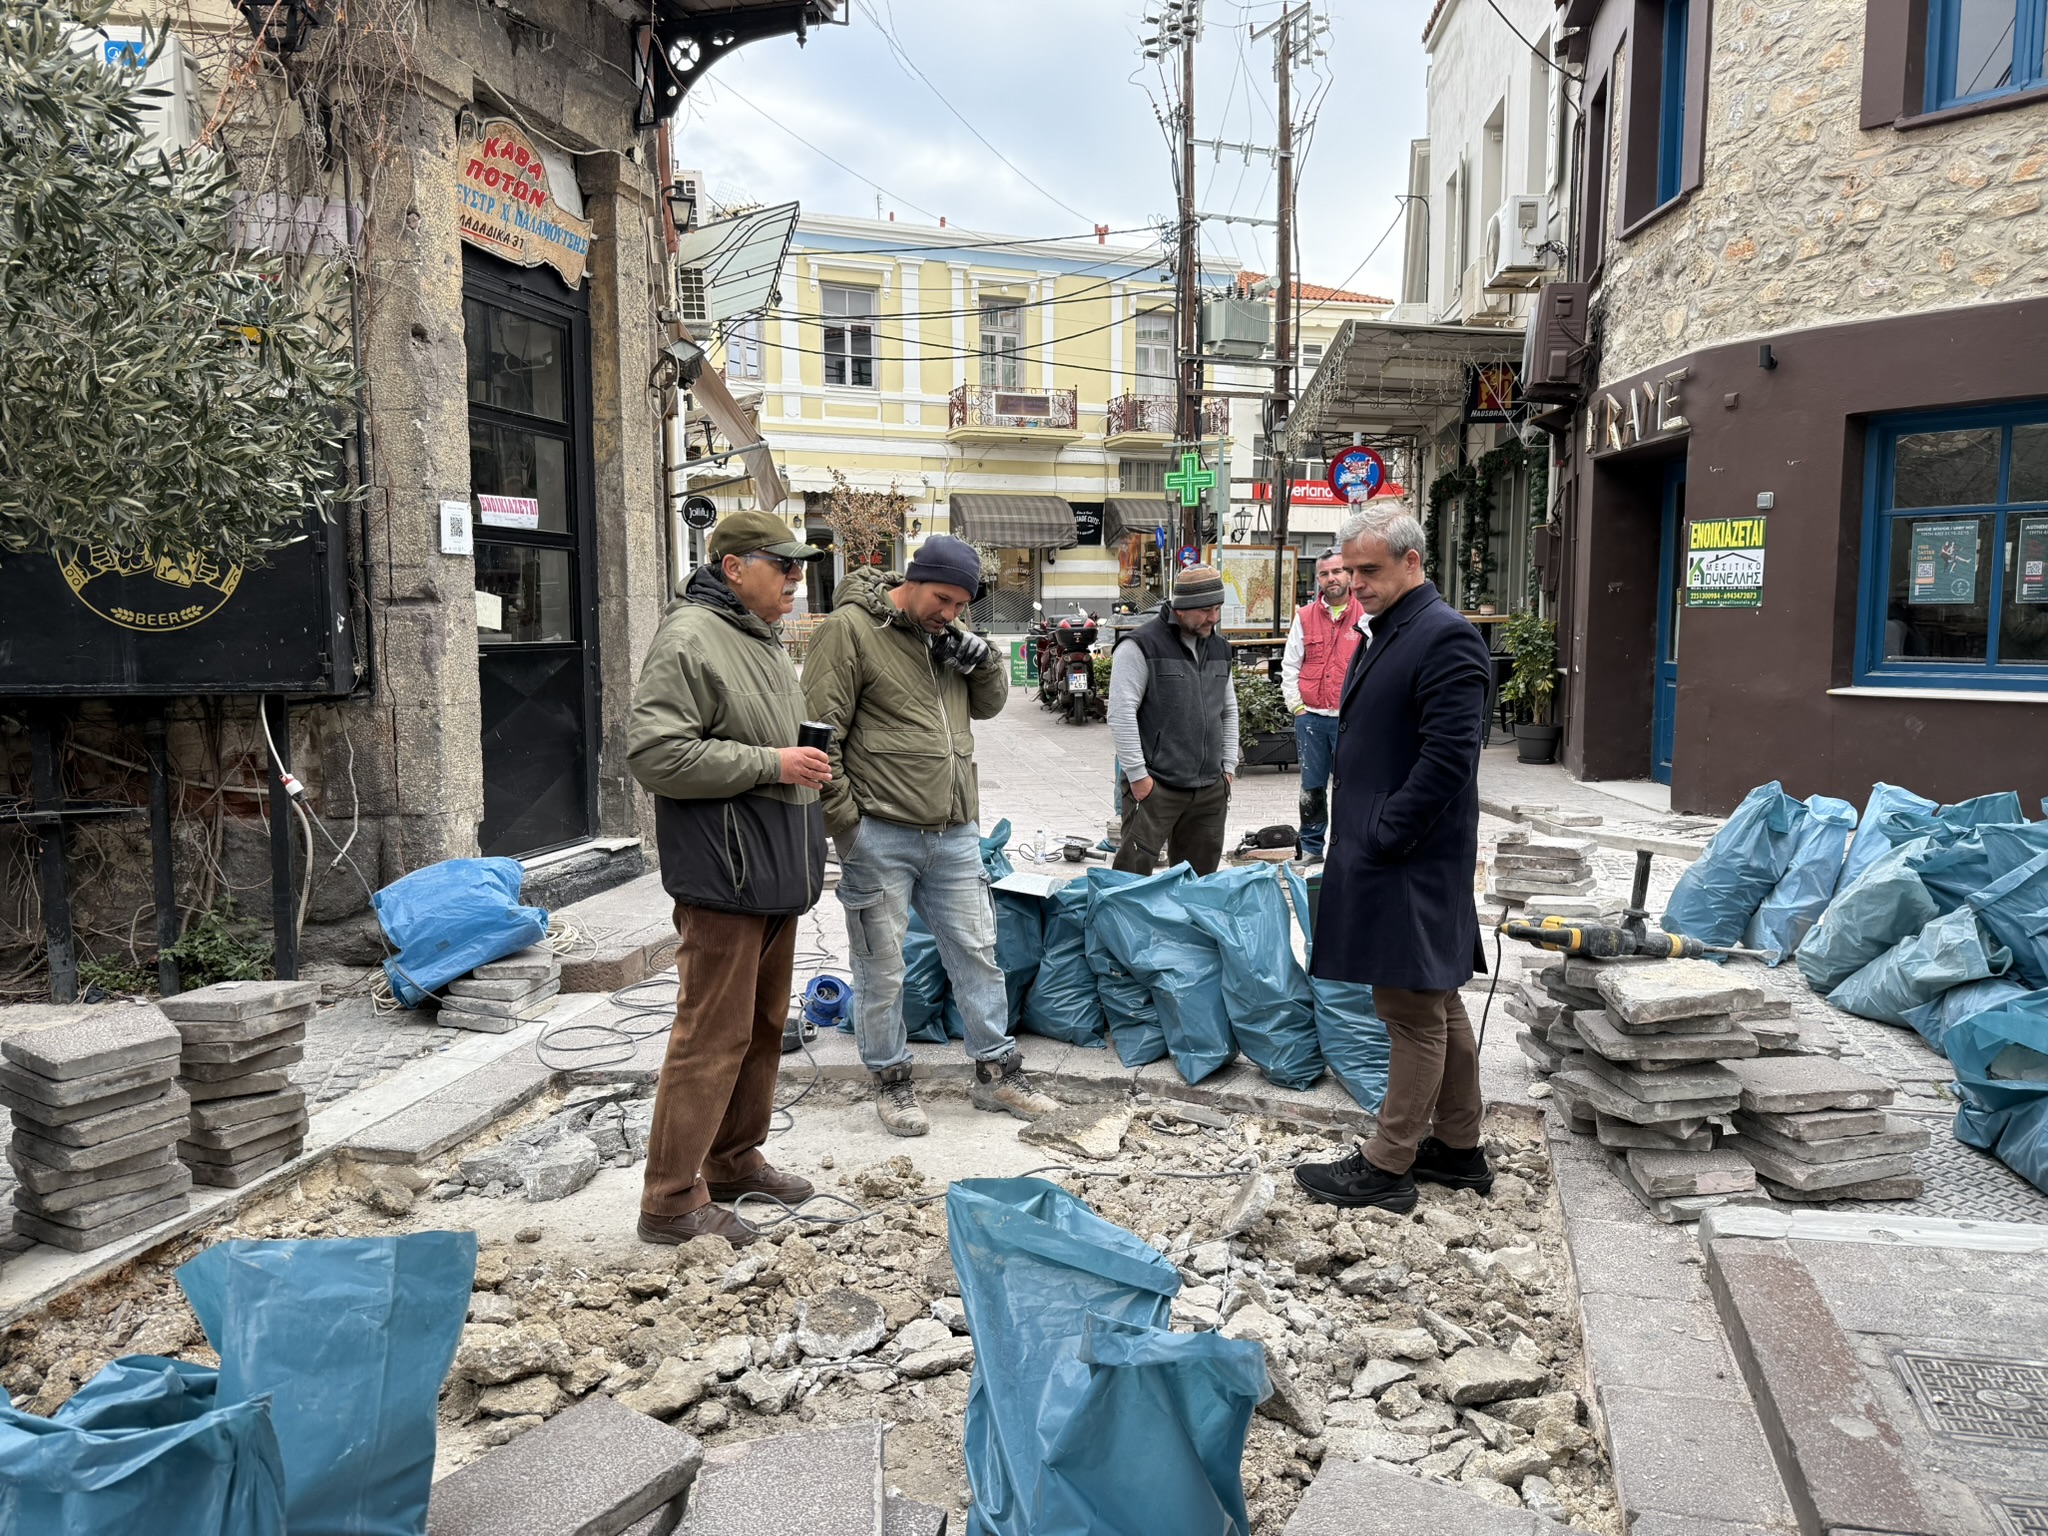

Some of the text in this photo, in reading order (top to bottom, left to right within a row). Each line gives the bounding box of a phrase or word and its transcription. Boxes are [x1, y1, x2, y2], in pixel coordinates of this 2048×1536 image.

[483, 137, 543, 181] ΚΑΒΑ
[465, 158, 546, 208] ΠΟΤΩΝ
[512, 235, 525, 250] 31
[479, 496, 539, 516] ΕΝΟΙΚΙΑΖΕΤΑΙ
[1690, 519, 1764, 549] ΕΝΟΙΚΙΑΖΕΤΑΙ
[135, 611, 181, 626] BEER
